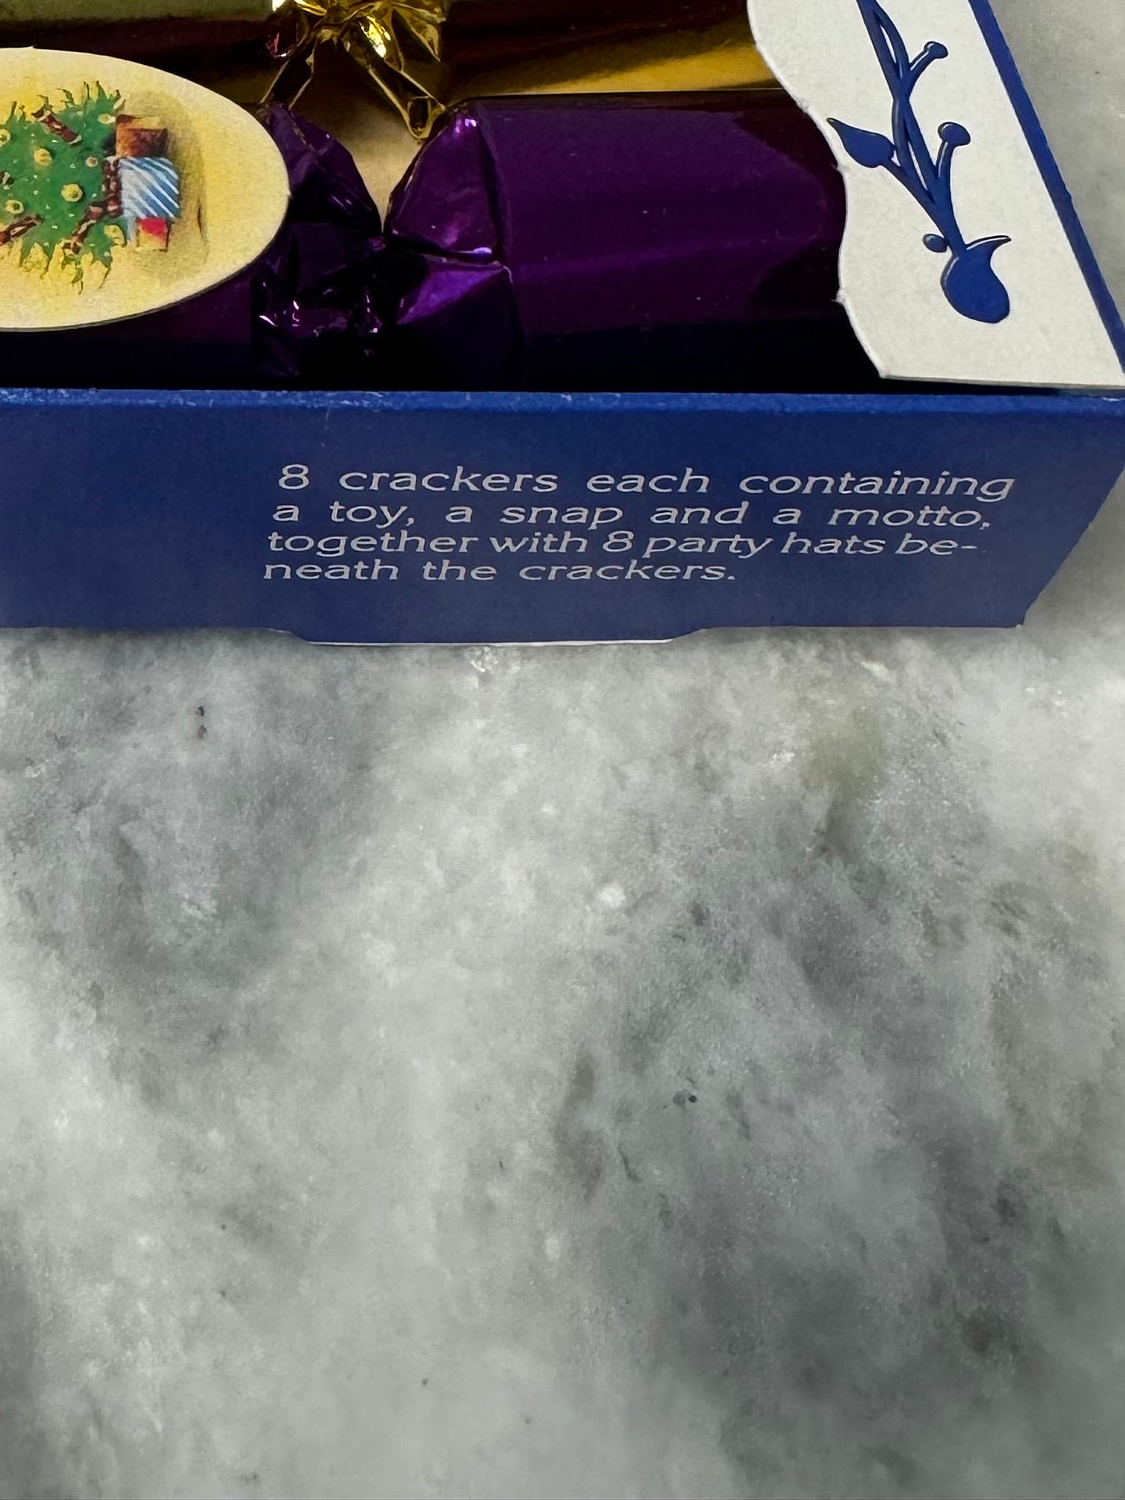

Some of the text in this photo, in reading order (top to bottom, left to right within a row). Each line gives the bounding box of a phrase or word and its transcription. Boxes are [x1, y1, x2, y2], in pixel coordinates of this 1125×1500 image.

[279, 464, 1014, 502] 8 crackers each containing
[273, 505, 299, 521] a
[330, 501, 414, 528] toy,
[445, 506, 472, 522] a
[500, 507, 624, 531] snap
[650, 501, 749, 524] and
[773, 508, 801, 524] a
[268, 530, 977, 558] together with 8 party hats be-
[264, 558, 735, 580] neath the crackers.
